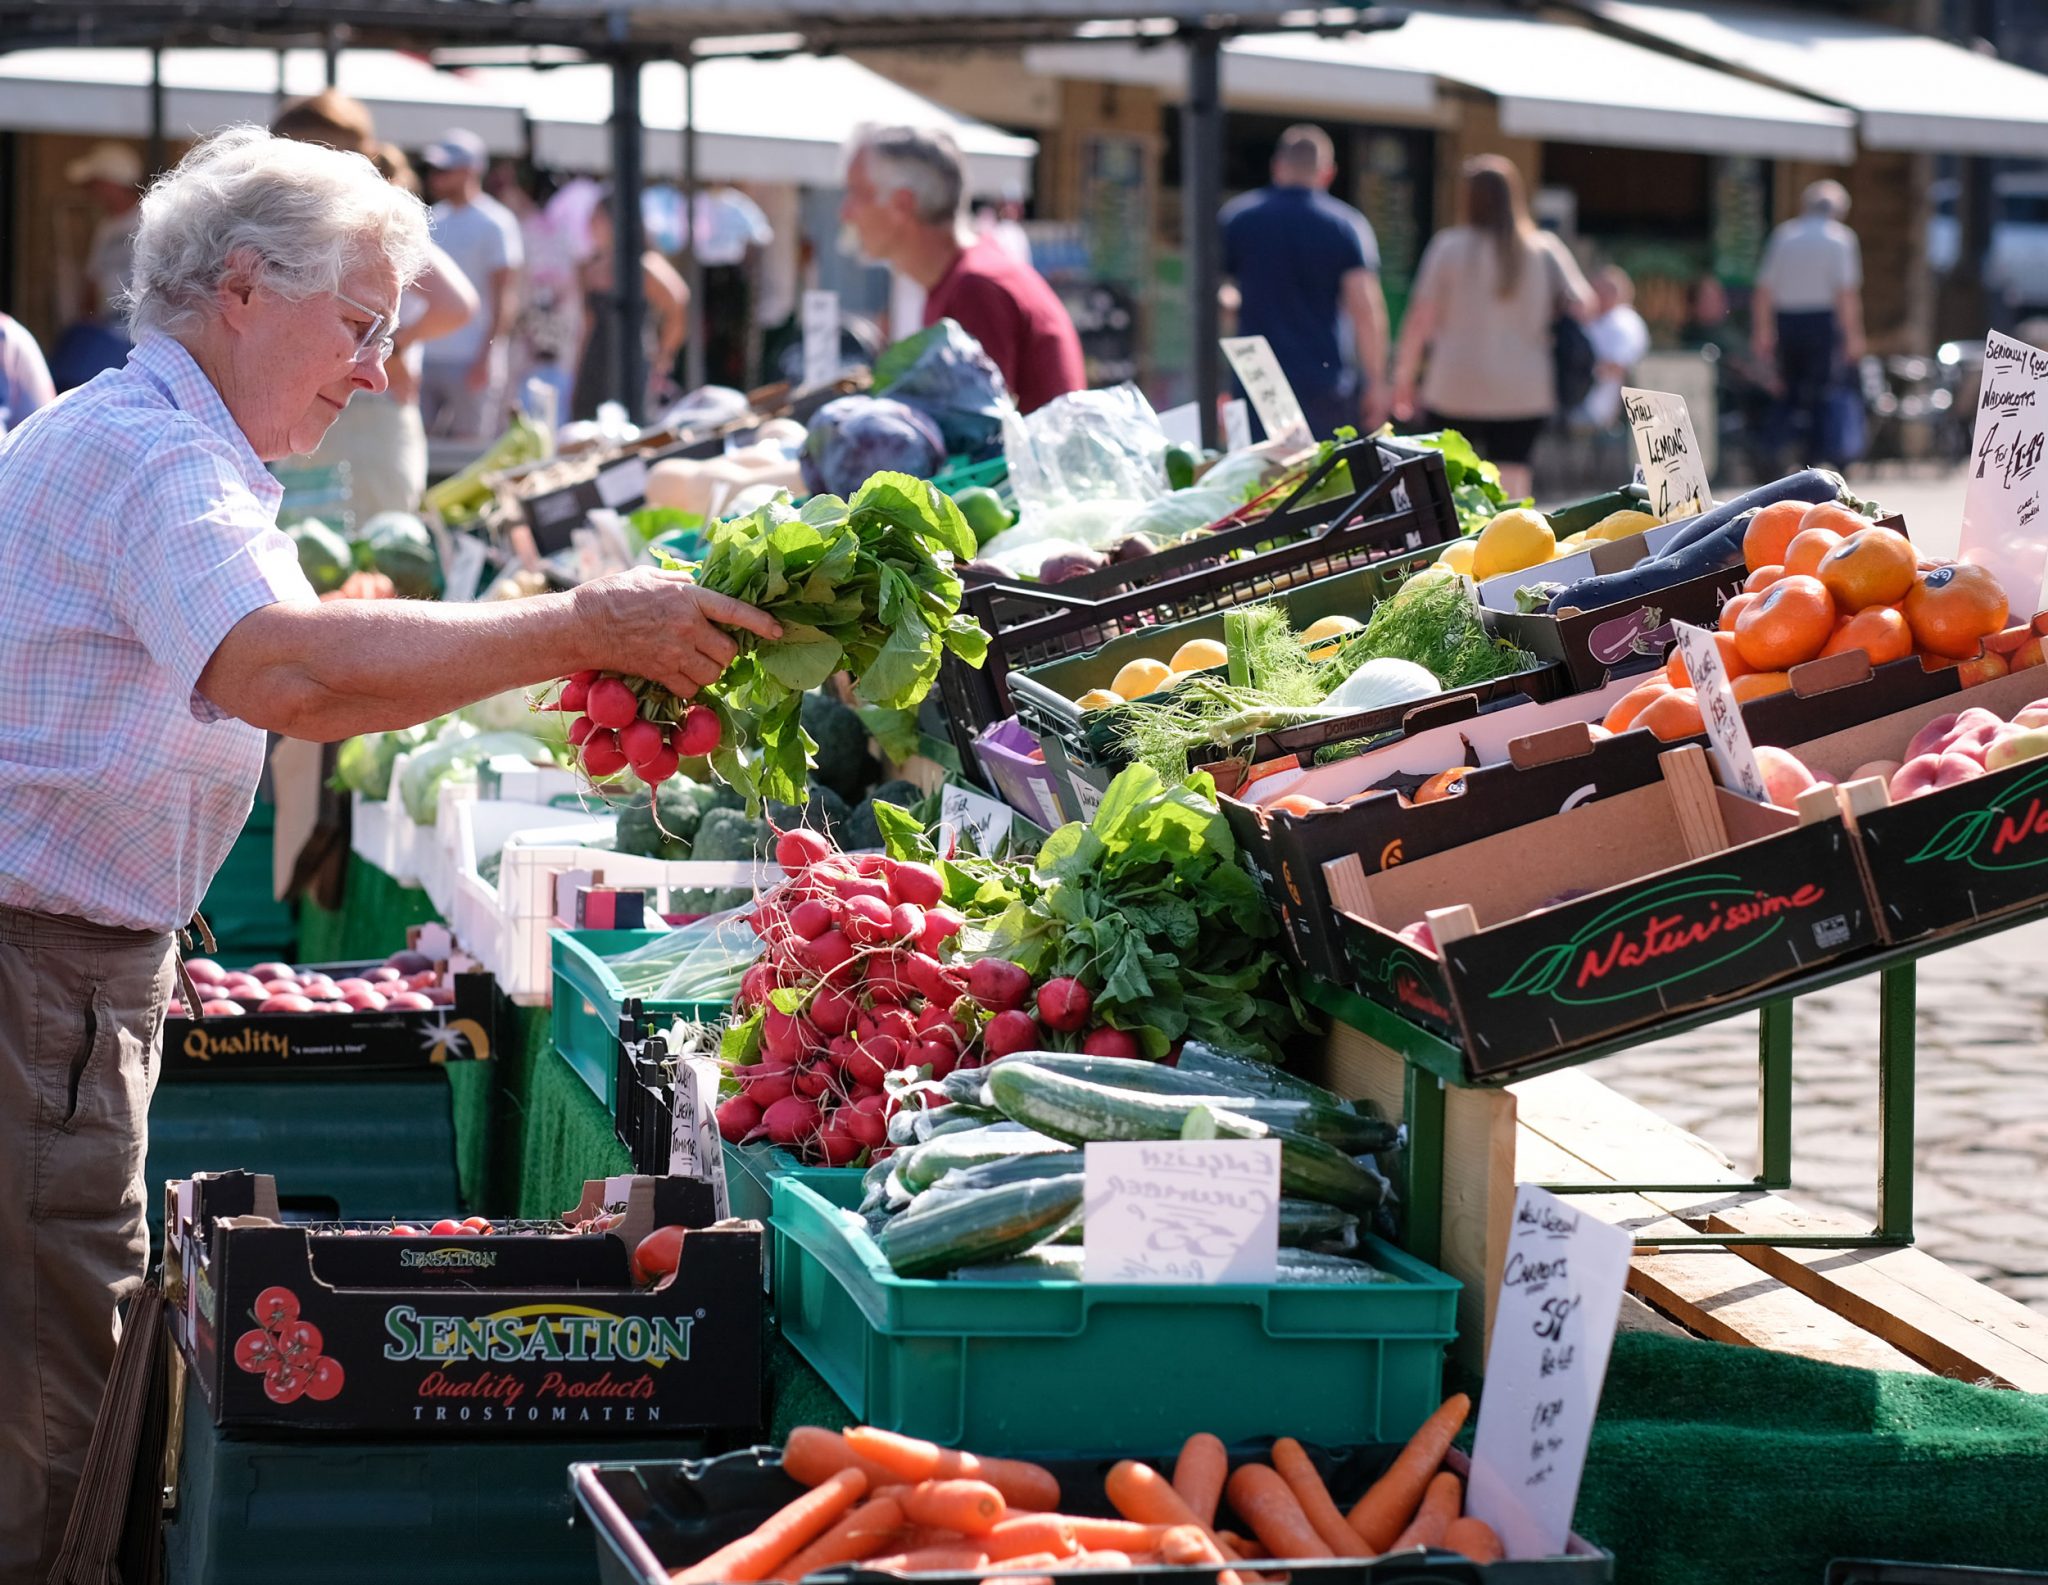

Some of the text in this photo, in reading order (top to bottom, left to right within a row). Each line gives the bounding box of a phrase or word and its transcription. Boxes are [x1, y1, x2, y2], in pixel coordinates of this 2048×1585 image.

[1645, 428, 1687, 465] LEMONS
[1576, 884, 1825, 988] Naturissime
[183, 1028, 289, 1061] Quality
[400, 1248, 497, 1267] SENSATION
[384, 1305, 694, 1362] SENSATION
[418, 1371, 656, 1406] Quality Products
[413, 1406, 660, 1421] TROSTOMATEN
